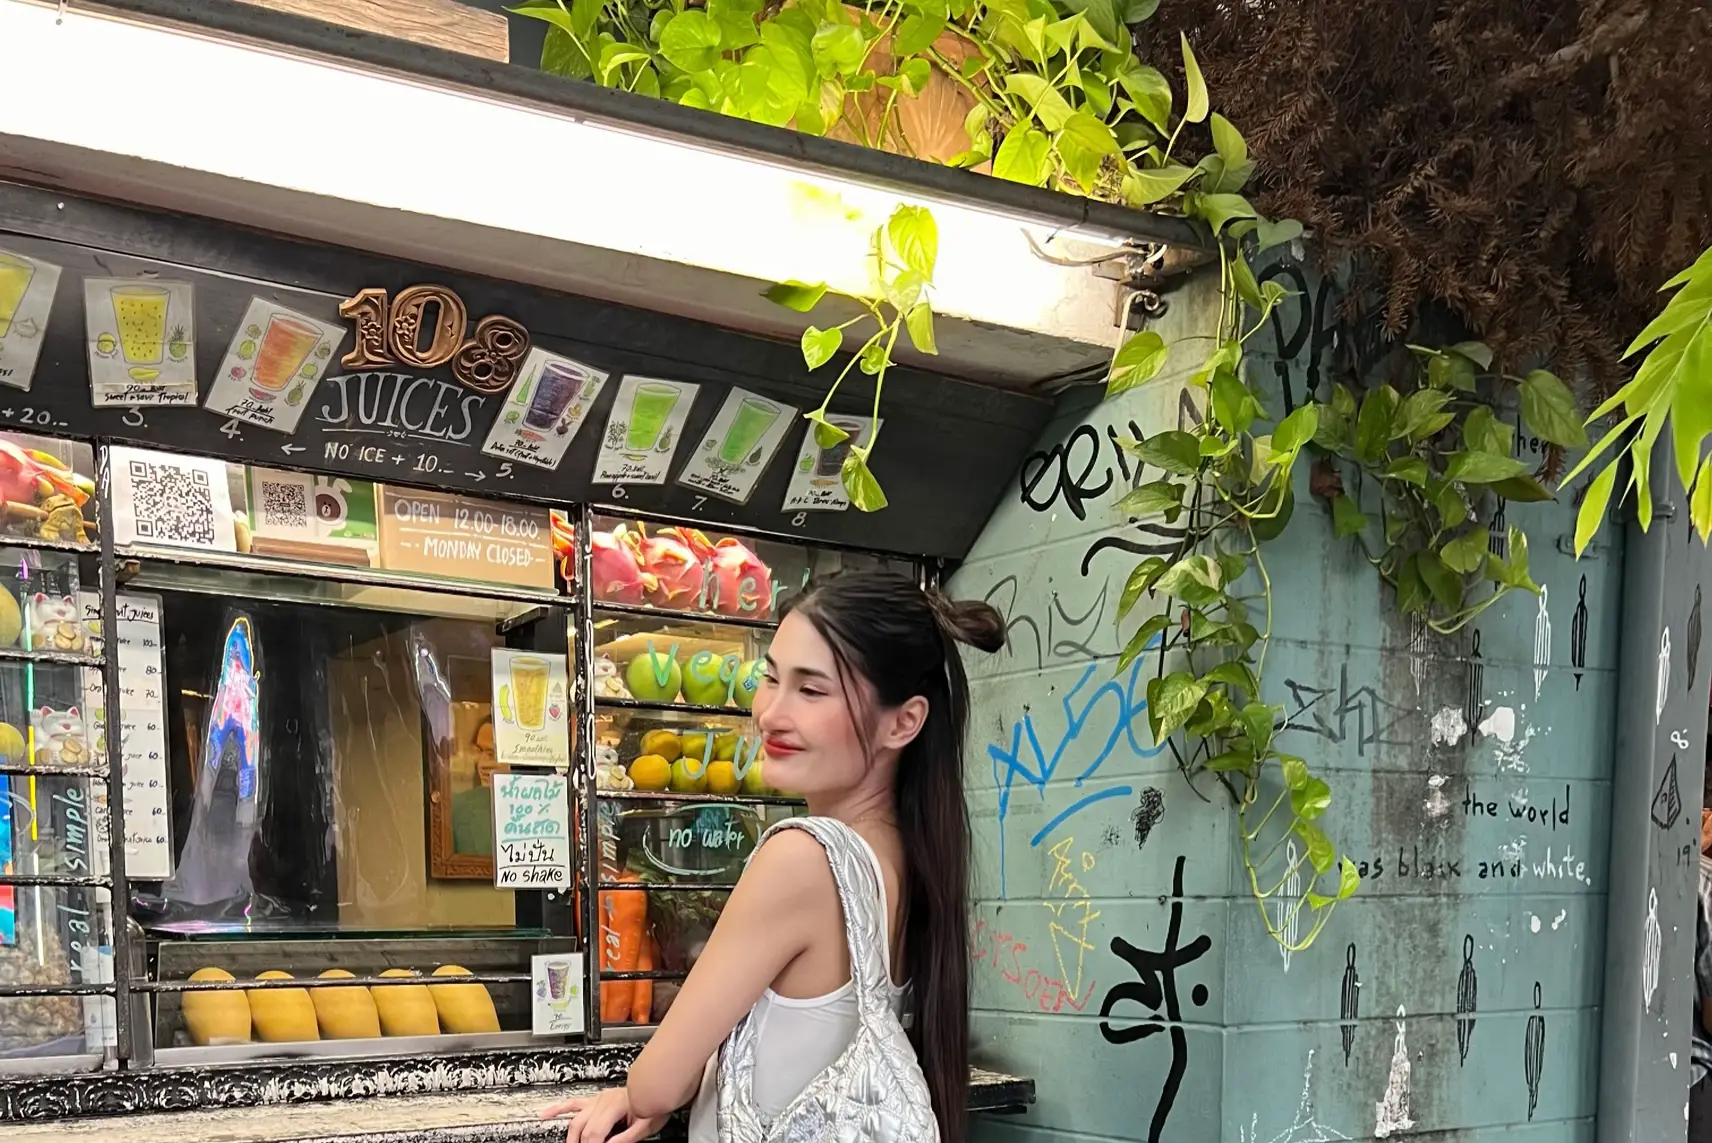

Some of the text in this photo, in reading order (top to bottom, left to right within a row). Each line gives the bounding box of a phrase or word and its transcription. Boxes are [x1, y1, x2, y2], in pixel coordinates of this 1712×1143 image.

[339, 283, 530, 394] 108
[315, 372, 487, 440] JUICES
[324, 441, 350, 461] NO
[358, 446, 386, 464] ICE
[394, 499, 440, 525] OPEN
[423, 537, 482, 562] MONDAY
[500, 775, 564, 800] น้ำผลไม้
[1462, 784, 1571, 831] the world
[500, 838, 555, 863] ไม่ปั่น
[668, 827, 693, 849] no
[1478, 859, 1522, 880] and
